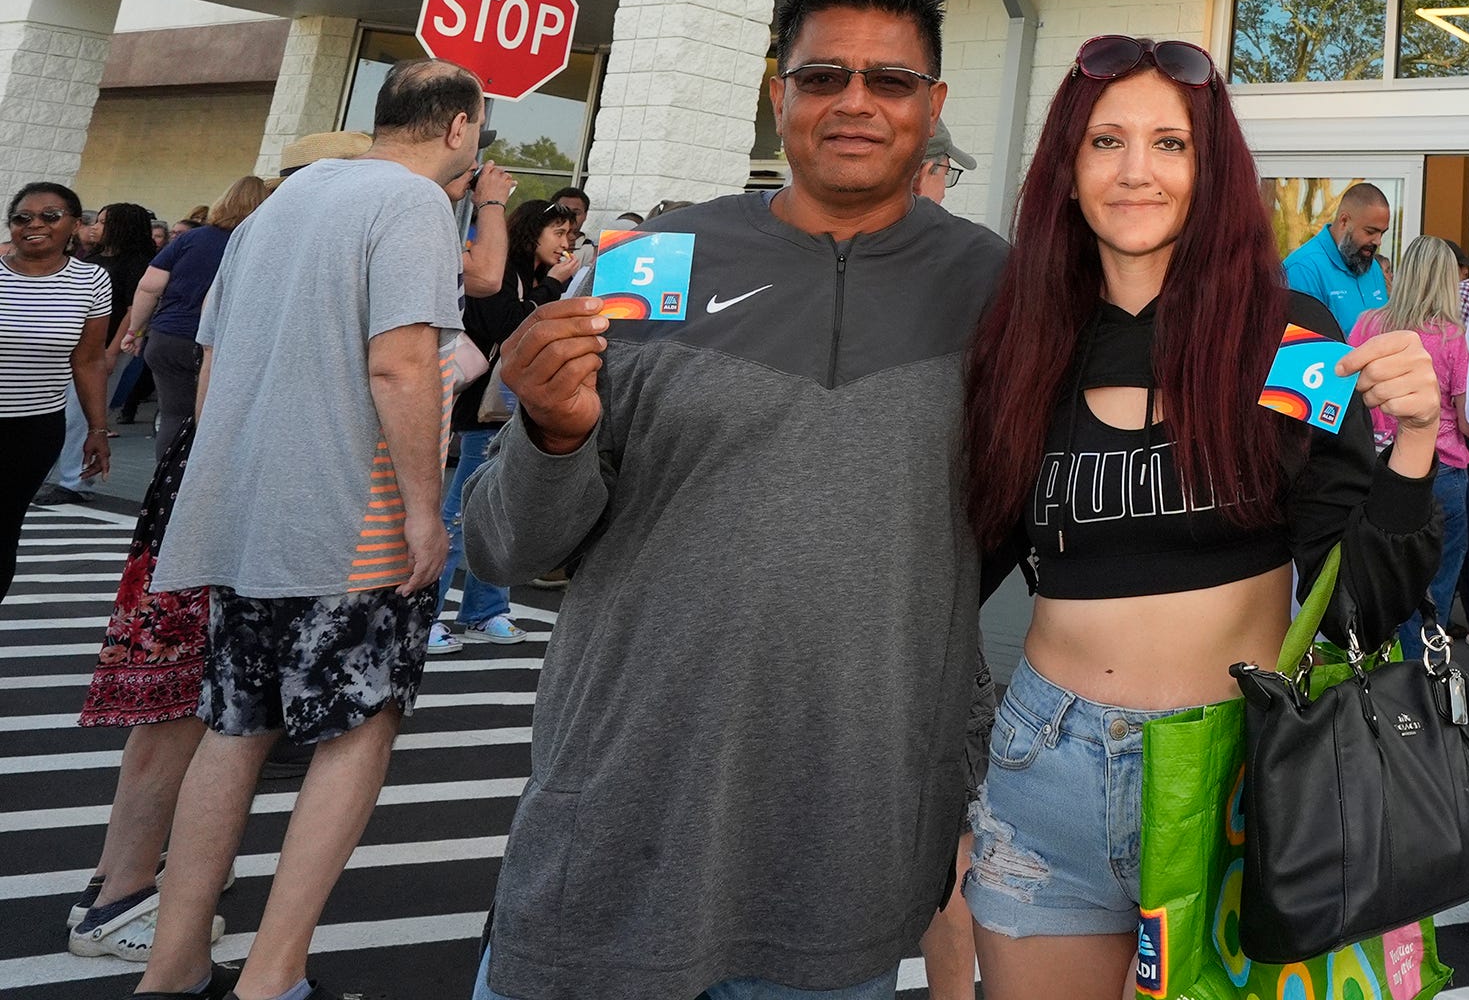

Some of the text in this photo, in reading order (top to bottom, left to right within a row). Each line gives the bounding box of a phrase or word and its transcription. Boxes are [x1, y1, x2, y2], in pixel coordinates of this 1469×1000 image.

[631, 257, 655, 286] 5
[1302, 362, 1325, 389] 6
[1322, 413, 1335, 422] ALDI
[1034, 440, 1258, 525] PUM
